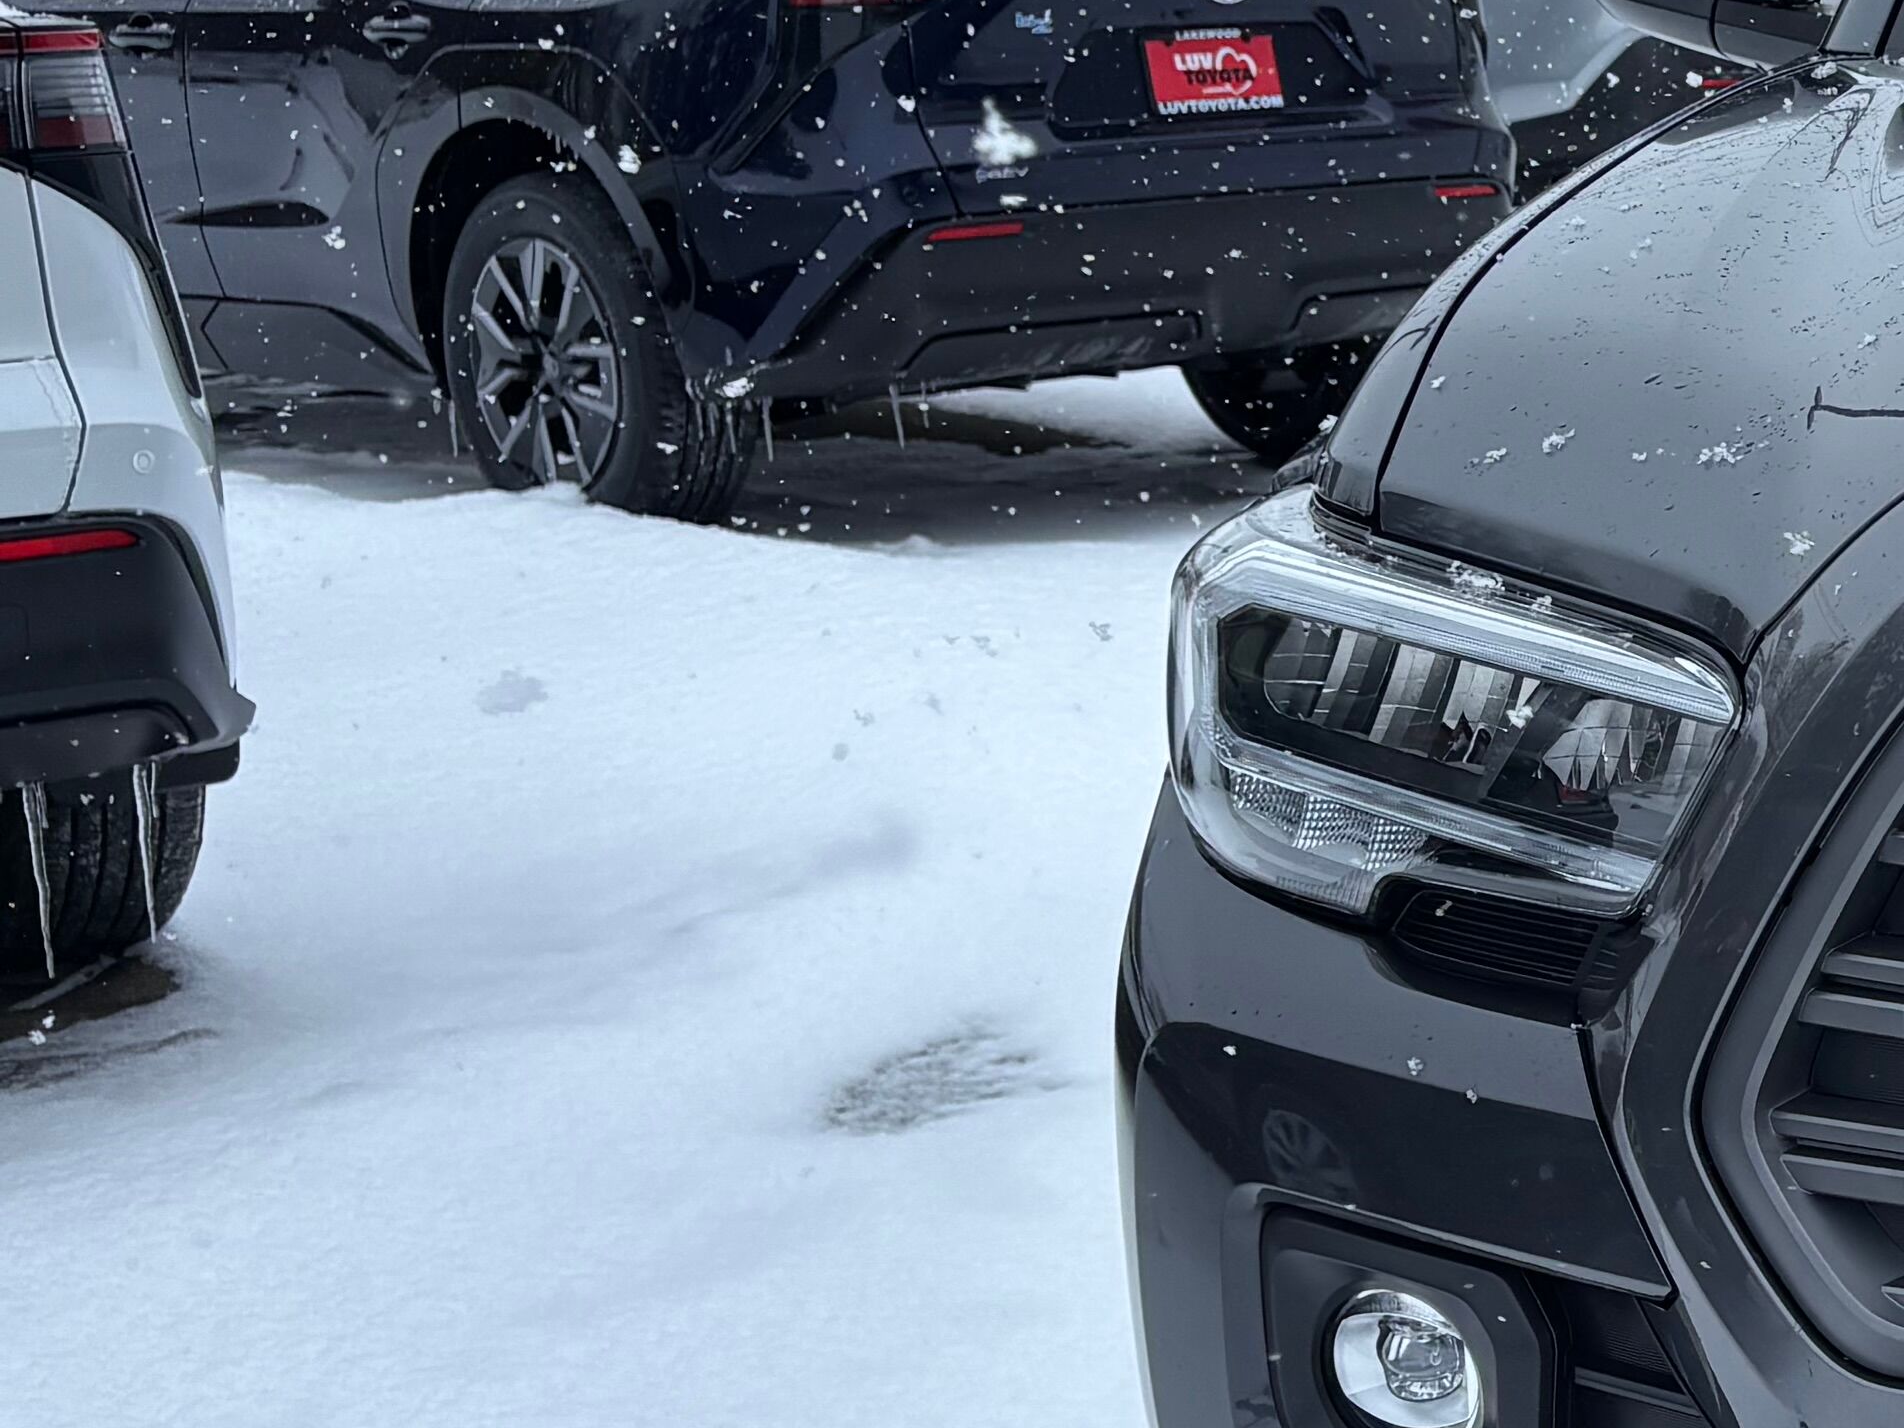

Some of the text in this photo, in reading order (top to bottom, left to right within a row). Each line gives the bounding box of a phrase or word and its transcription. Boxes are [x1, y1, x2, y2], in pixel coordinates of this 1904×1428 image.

[1173, 52, 1213, 72] LUV
[1183, 68, 1254, 86] TOYOTA
[1157, 94, 1285, 115] LUVTOYOTA.COM
